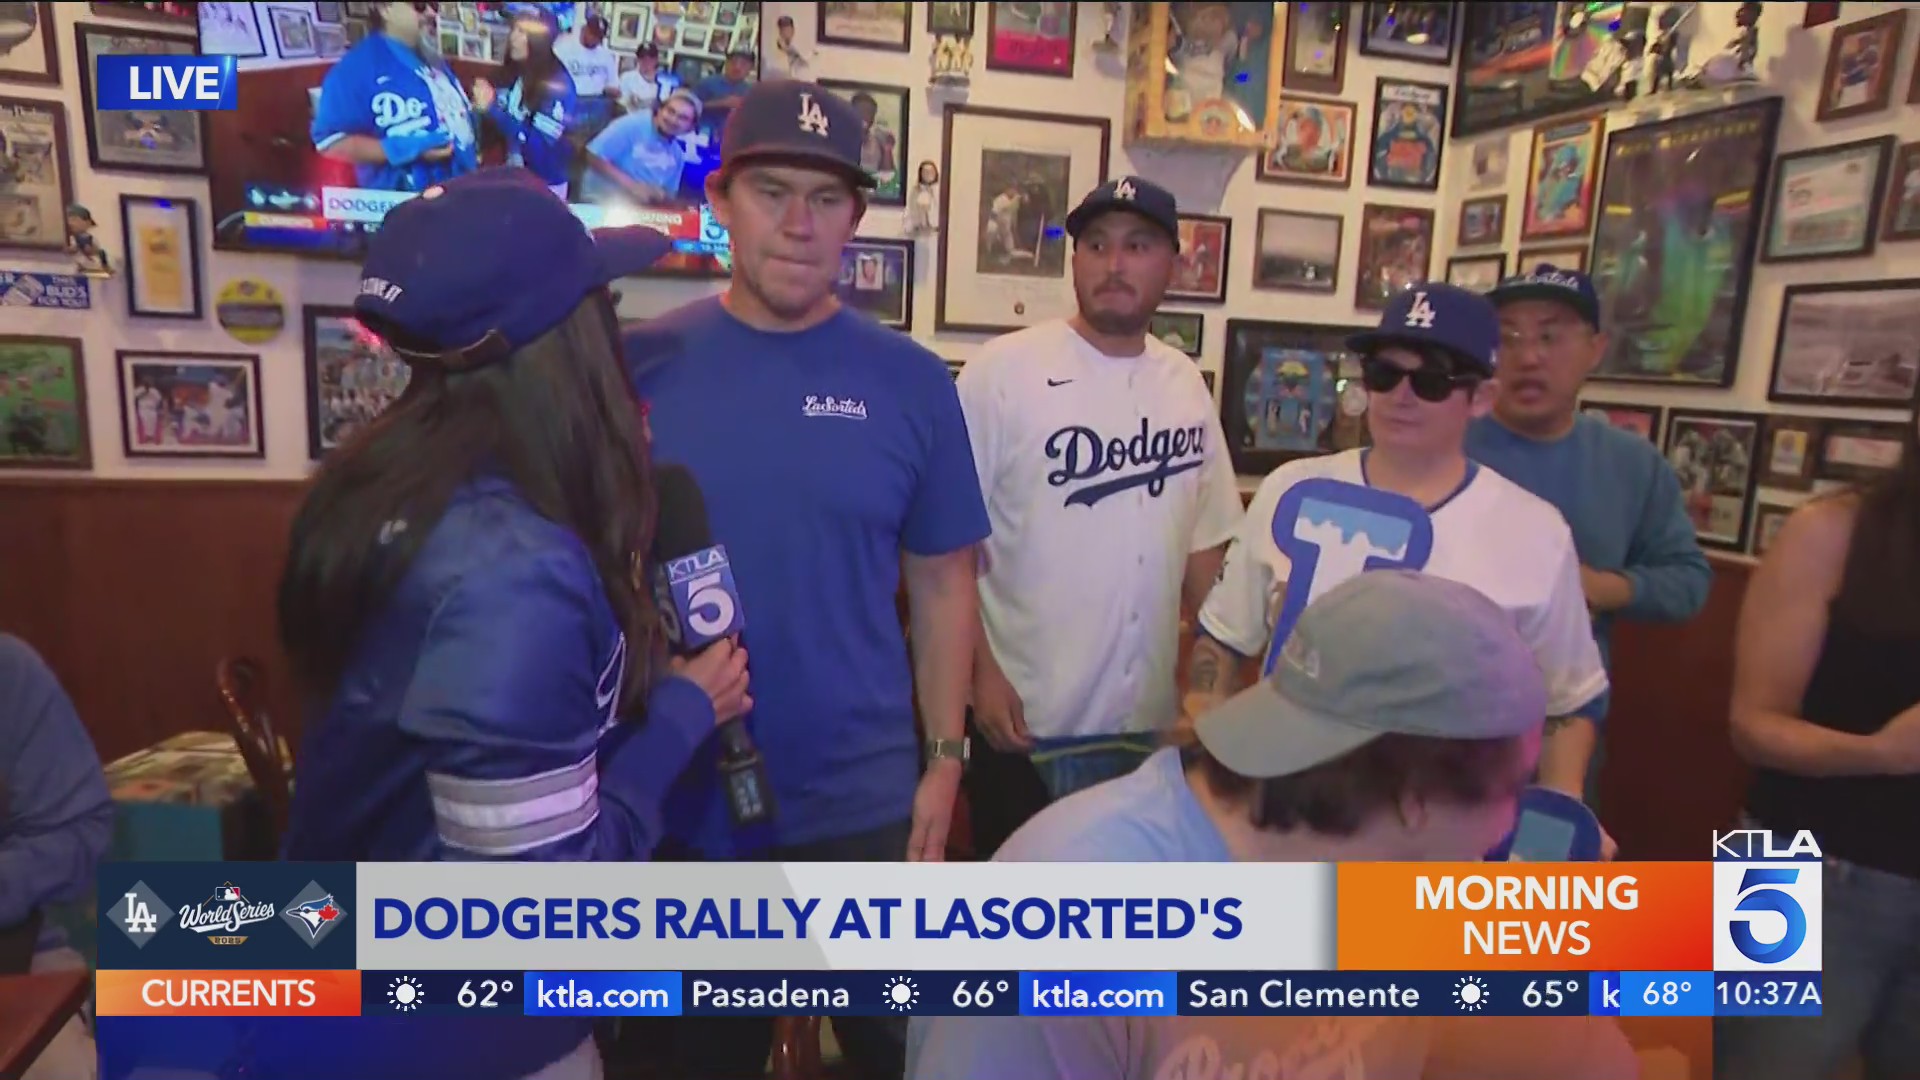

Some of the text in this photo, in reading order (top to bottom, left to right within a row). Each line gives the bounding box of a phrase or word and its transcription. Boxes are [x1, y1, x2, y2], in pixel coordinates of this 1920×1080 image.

[798, 93, 829, 137] LA
[1112, 176, 1136, 200] LA
[1405, 291, 1436, 328] LA
[668, 549, 726, 580] KTLA
[687, 571, 735, 636] 5
